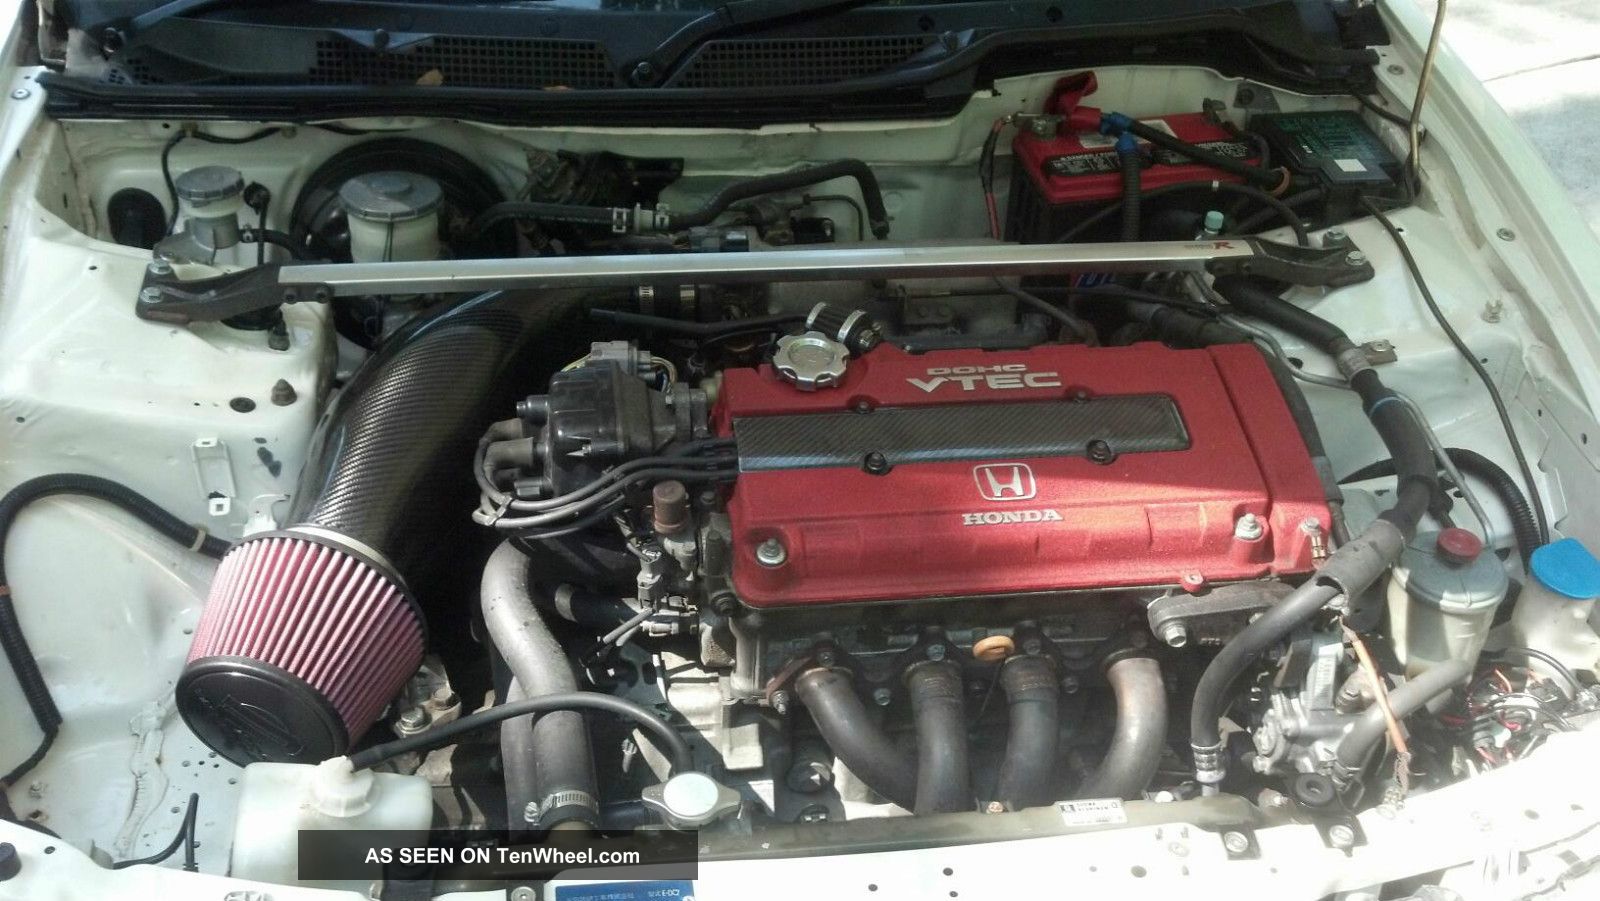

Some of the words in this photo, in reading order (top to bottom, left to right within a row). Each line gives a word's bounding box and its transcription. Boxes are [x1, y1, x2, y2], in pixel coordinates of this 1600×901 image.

[927, 364, 1027, 376] DOHC
[906, 372, 1062, 393] VTEC
[961, 509, 1064, 526] HONDA
